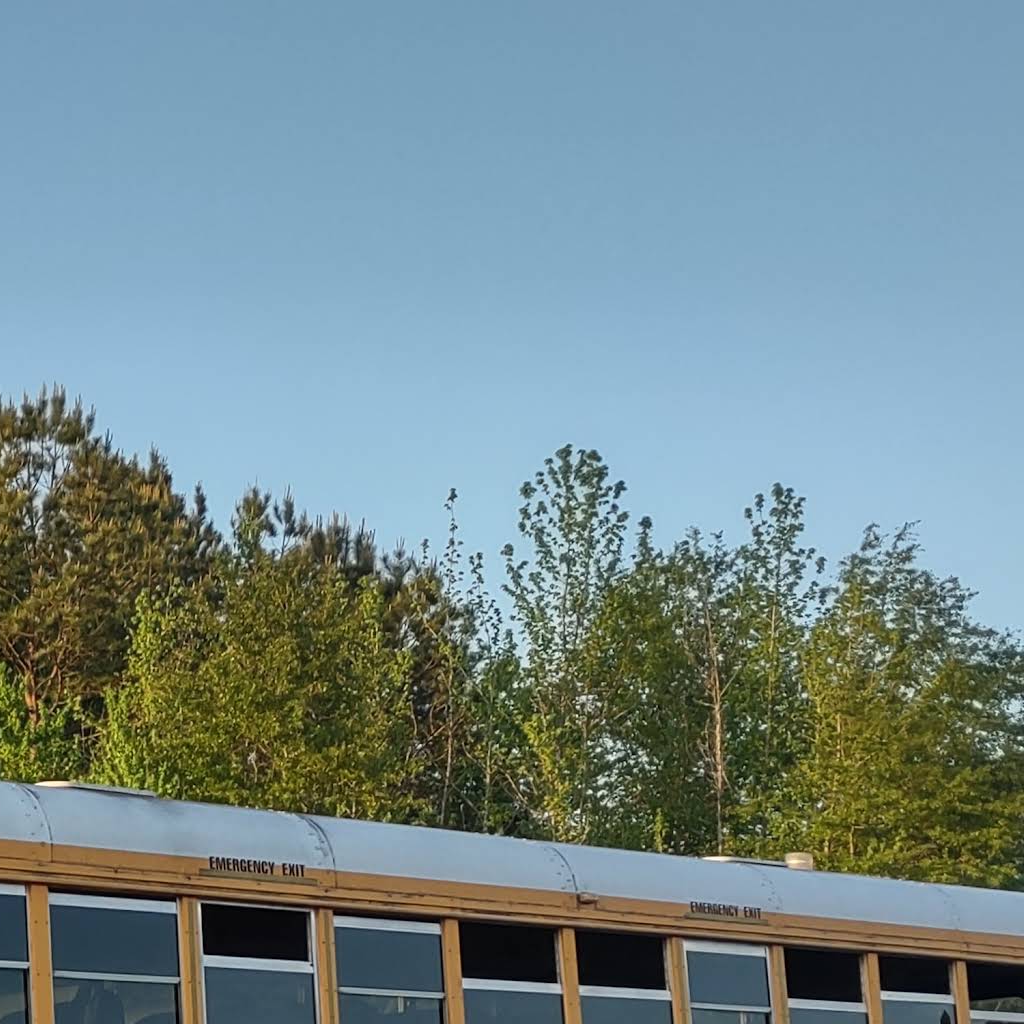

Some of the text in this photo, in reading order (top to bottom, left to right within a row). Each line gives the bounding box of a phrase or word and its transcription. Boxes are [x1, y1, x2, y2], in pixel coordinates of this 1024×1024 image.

[209, 856, 305, 877] EMERGENCY EXIT
[690, 901, 762, 919] EMERGENCY EXIT
